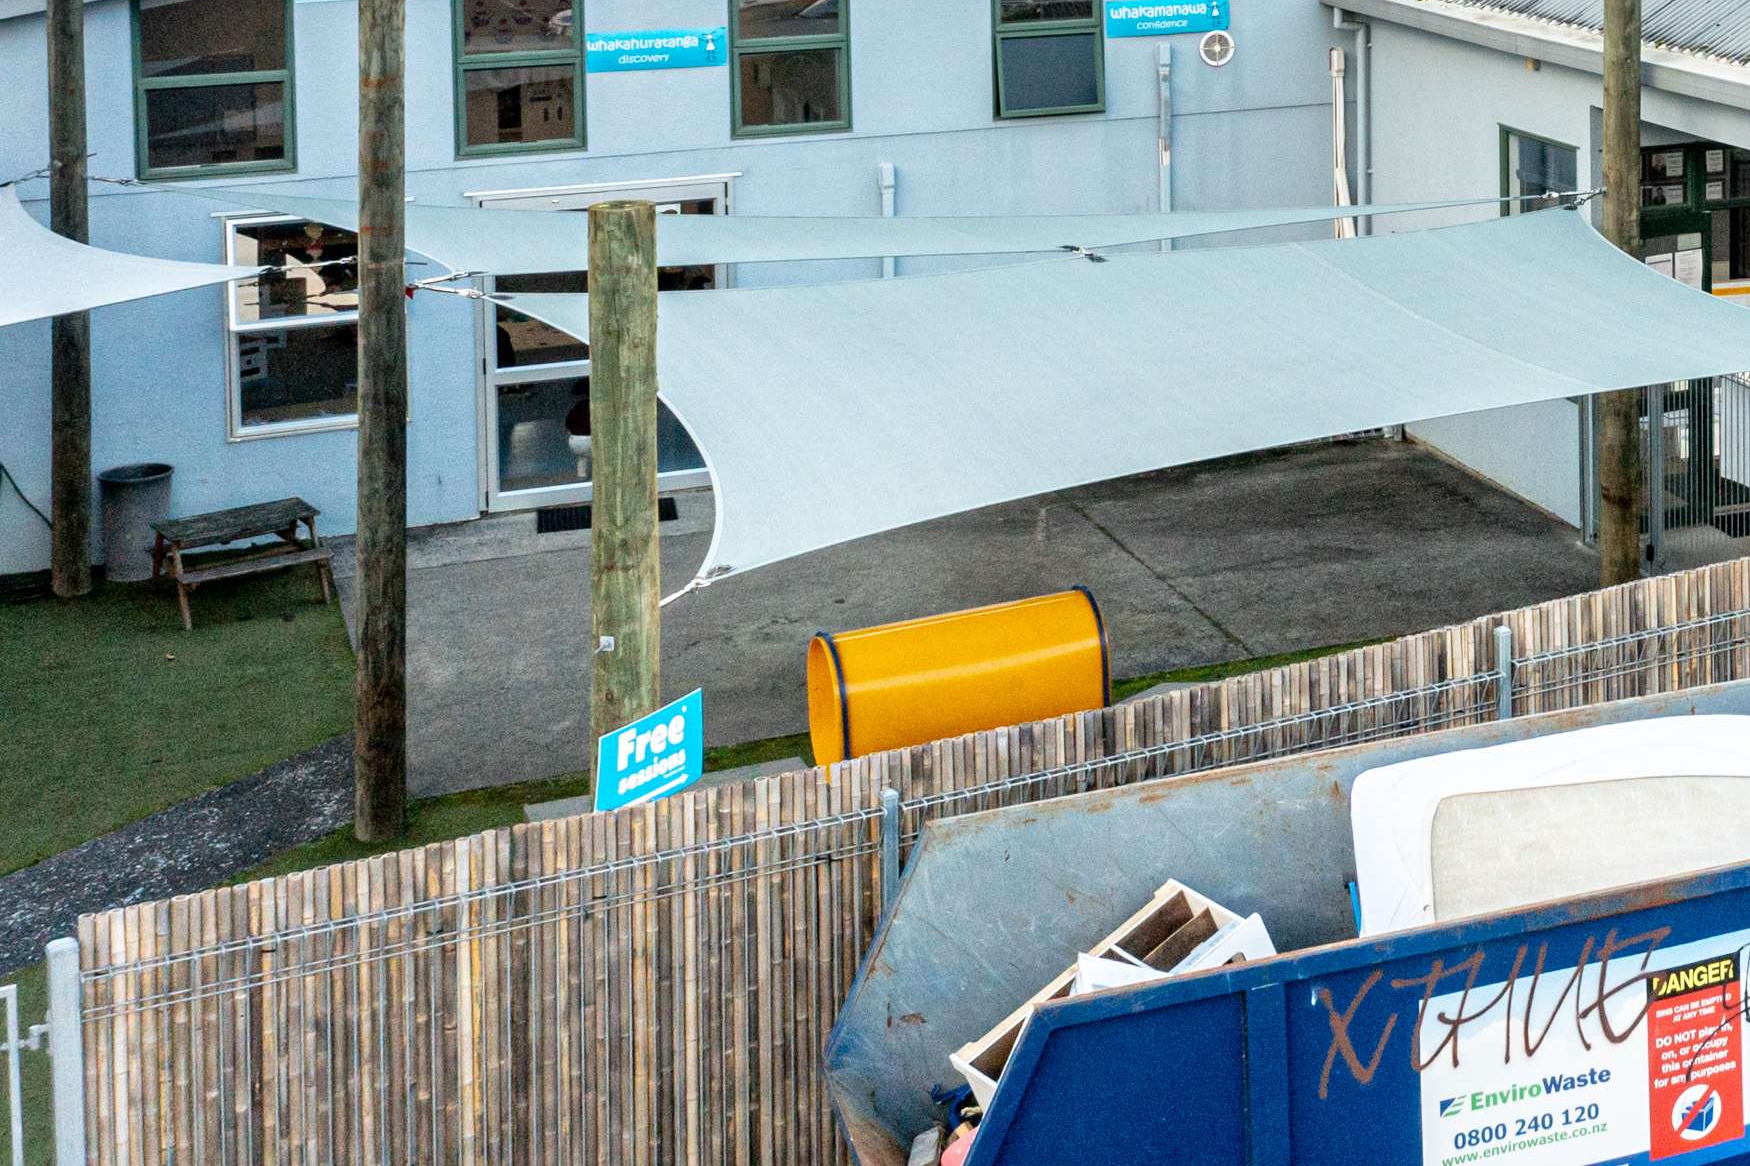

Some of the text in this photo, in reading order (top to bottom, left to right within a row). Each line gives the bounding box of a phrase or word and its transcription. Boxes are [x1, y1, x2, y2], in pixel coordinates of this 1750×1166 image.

[1110, 2, 1207, 20] whakamanawa
[1136, 20, 1188, 30] confidence
[587, 36, 698, 52] whakahuratanga
[618, 54, 669, 65] discovery
[618, 749, 686, 794] sessions
[1653, 959, 1734, 995] DANGER
[1656, 1008, 1673, 1018] BINS
[1674, 1004, 1689, 1013] CAN
[1690, 1001, 1700, 1009] BE
[1673, 1006, 1715, 1022] AT ANY TIME
[1656, 1036, 1672, 1048] DO
[1674, 1029, 1697, 1044] NOT
[1662, 1050, 1677, 1060] on,
[1680, 1045, 1691, 1055] or
[1654, 1078, 1669, 1088] for
[1691, 1061, 1736, 1081] purposes
[1662, 1061, 1680, 1073] this
[1470, 1066, 1611, 1111] EnviroWaste
[1454, 1103, 1600, 1150] 0800 240 120
[1442, 1122, 1608, 1166] www.envirowaste.co.nz
